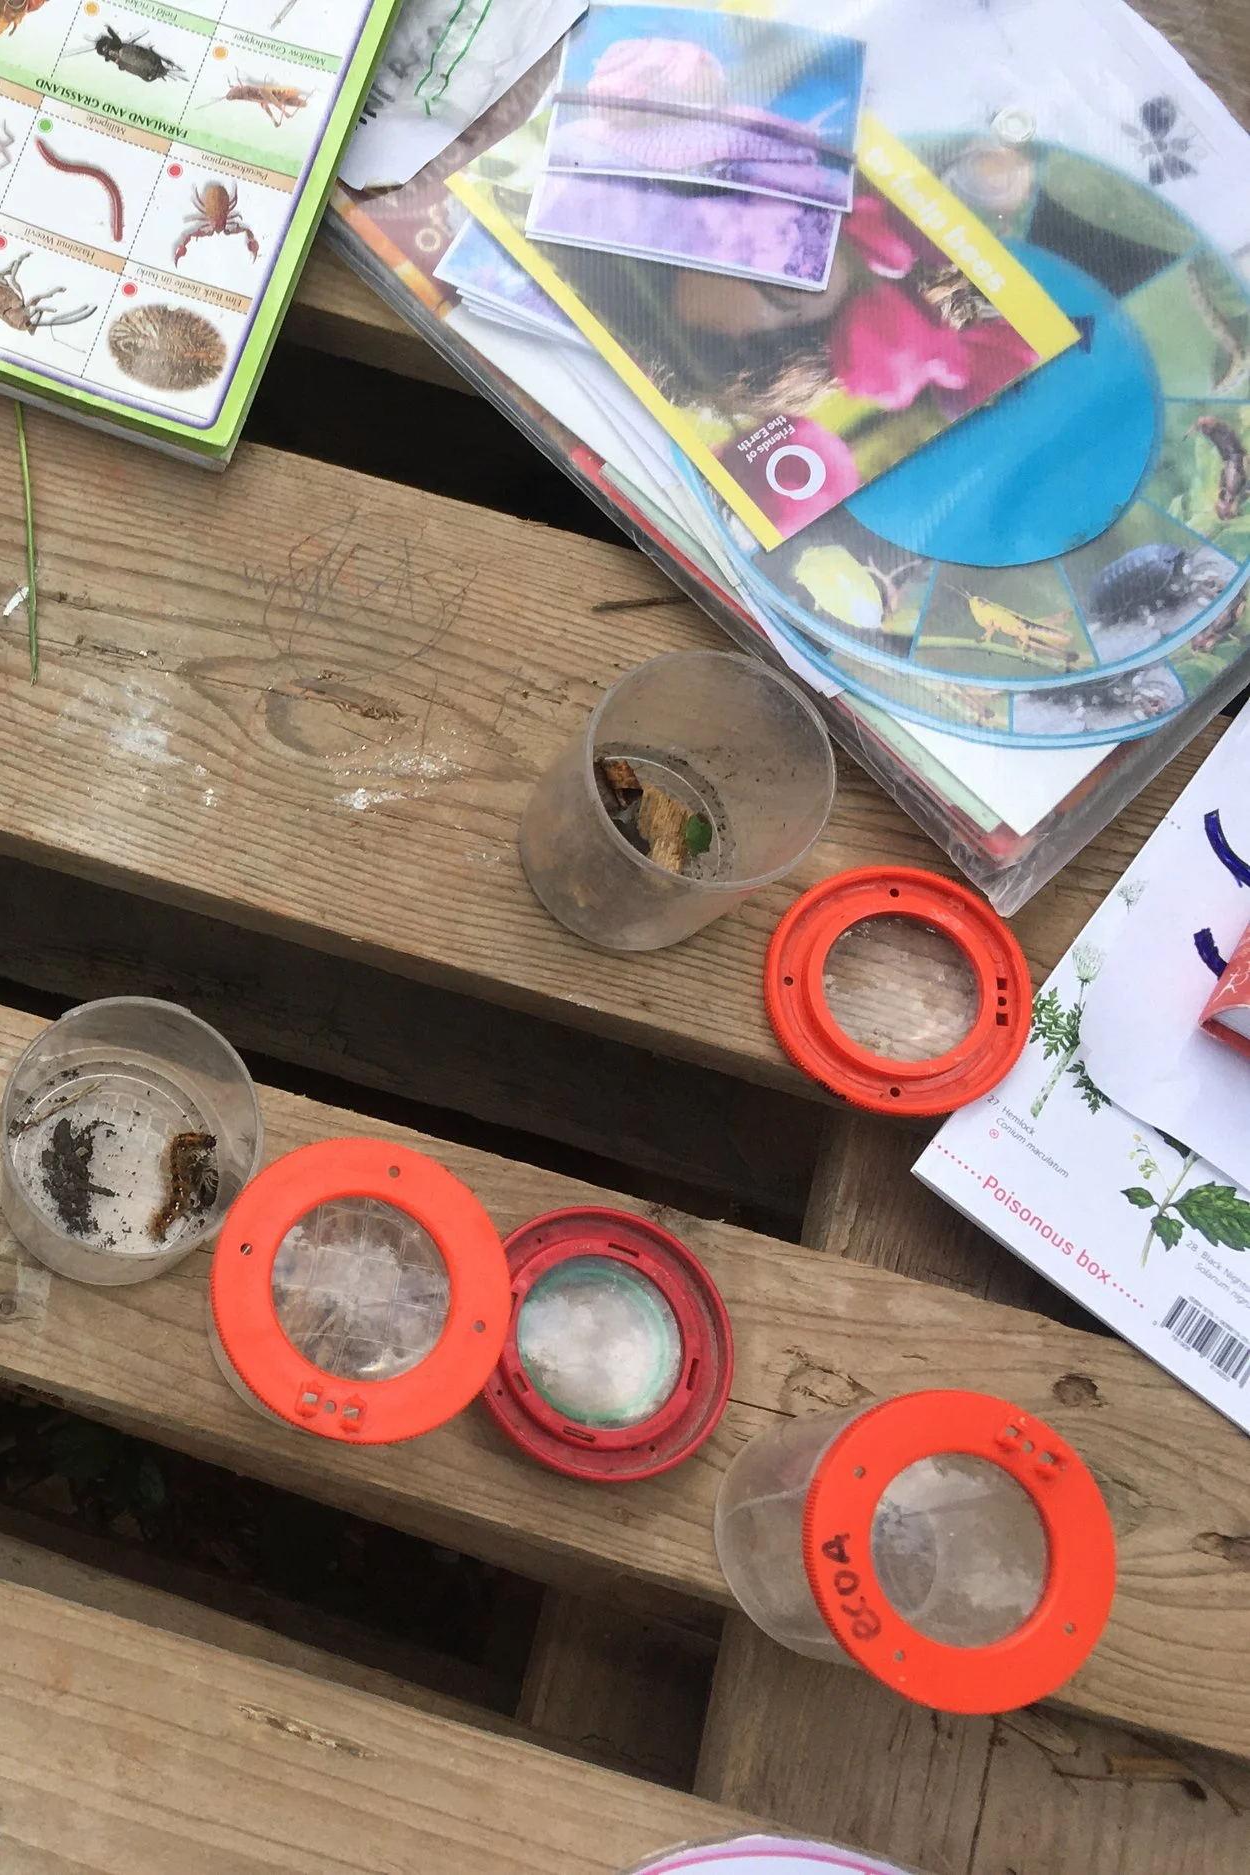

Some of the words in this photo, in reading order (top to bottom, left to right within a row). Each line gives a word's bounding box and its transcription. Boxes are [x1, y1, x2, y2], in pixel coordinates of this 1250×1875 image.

[233, 33, 286, 54] Grasshopper
[287, 48, 326, 66] Meadow
[35, 77, 100, 109] GRASSLAND
[101, 102, 130, 119] AND
[85, 112, 127, 136] Millipede
[128, 112, 189, 139] FARMLAND
[24, 226, 55, 246] Weevil
[891, 172, 948, 231] help
[943, 224, 1007, 293] bees
[56, 239, 96, 261] Hazelnut
[204, 287, 224, 301] Bark
[766, 414, 787, 431] the
[736, 427, 770, 452] Earth
[756, 423, 796, 453] Friends
[745, 449, 758, 464] of
[1002, 1105, 1036, 1137] Hemlock
[995, 1117, 1027, 1144] Conium
[1025, 1141, 1070, 1179] maculatum
[982, 1174, 1075, 1256] Poisonous
[1075, 1248, 1111, 1285] box
[1200, 1251, 1223, 1271] Black
[1194, 1261, 1230, 1293] Solanum
